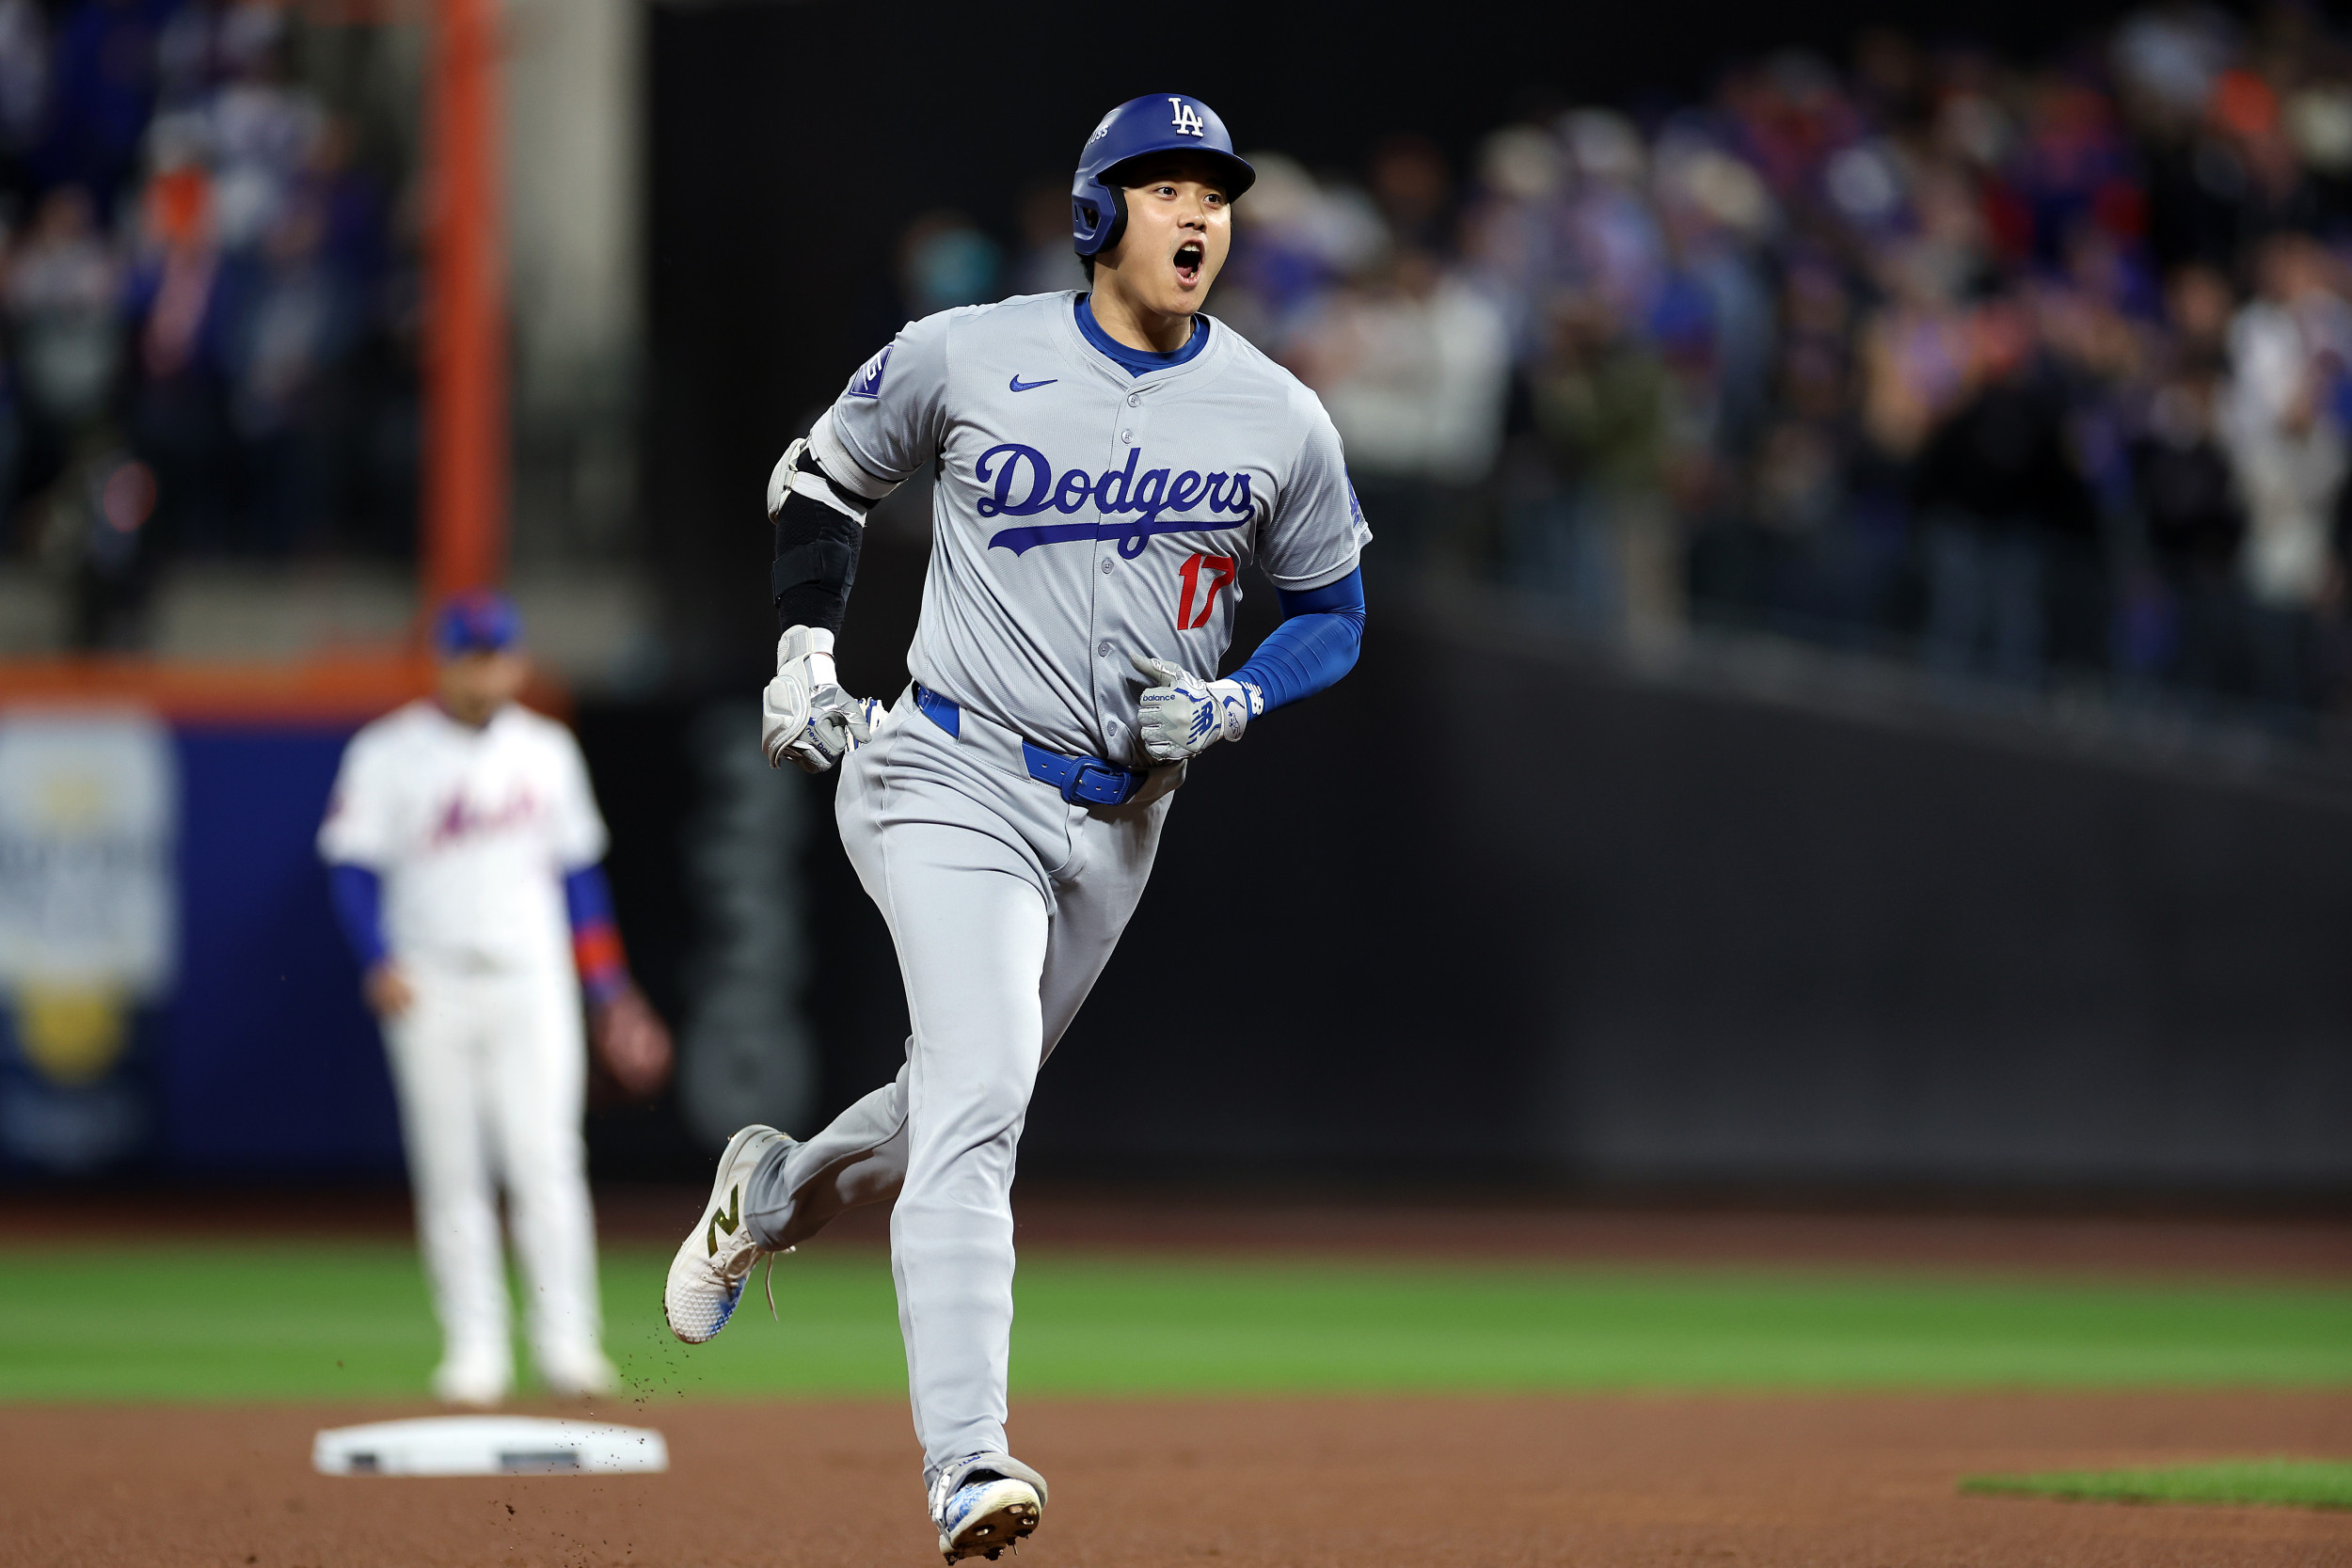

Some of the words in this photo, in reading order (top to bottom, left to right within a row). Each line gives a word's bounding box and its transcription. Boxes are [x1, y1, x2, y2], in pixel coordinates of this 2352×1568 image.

[1168, 97, 1204, 137] LA
[975, 443, 1255, 560] Dodgers
[1177, 553, 1234, 630] 17
[806, 727, 818, 742] new
